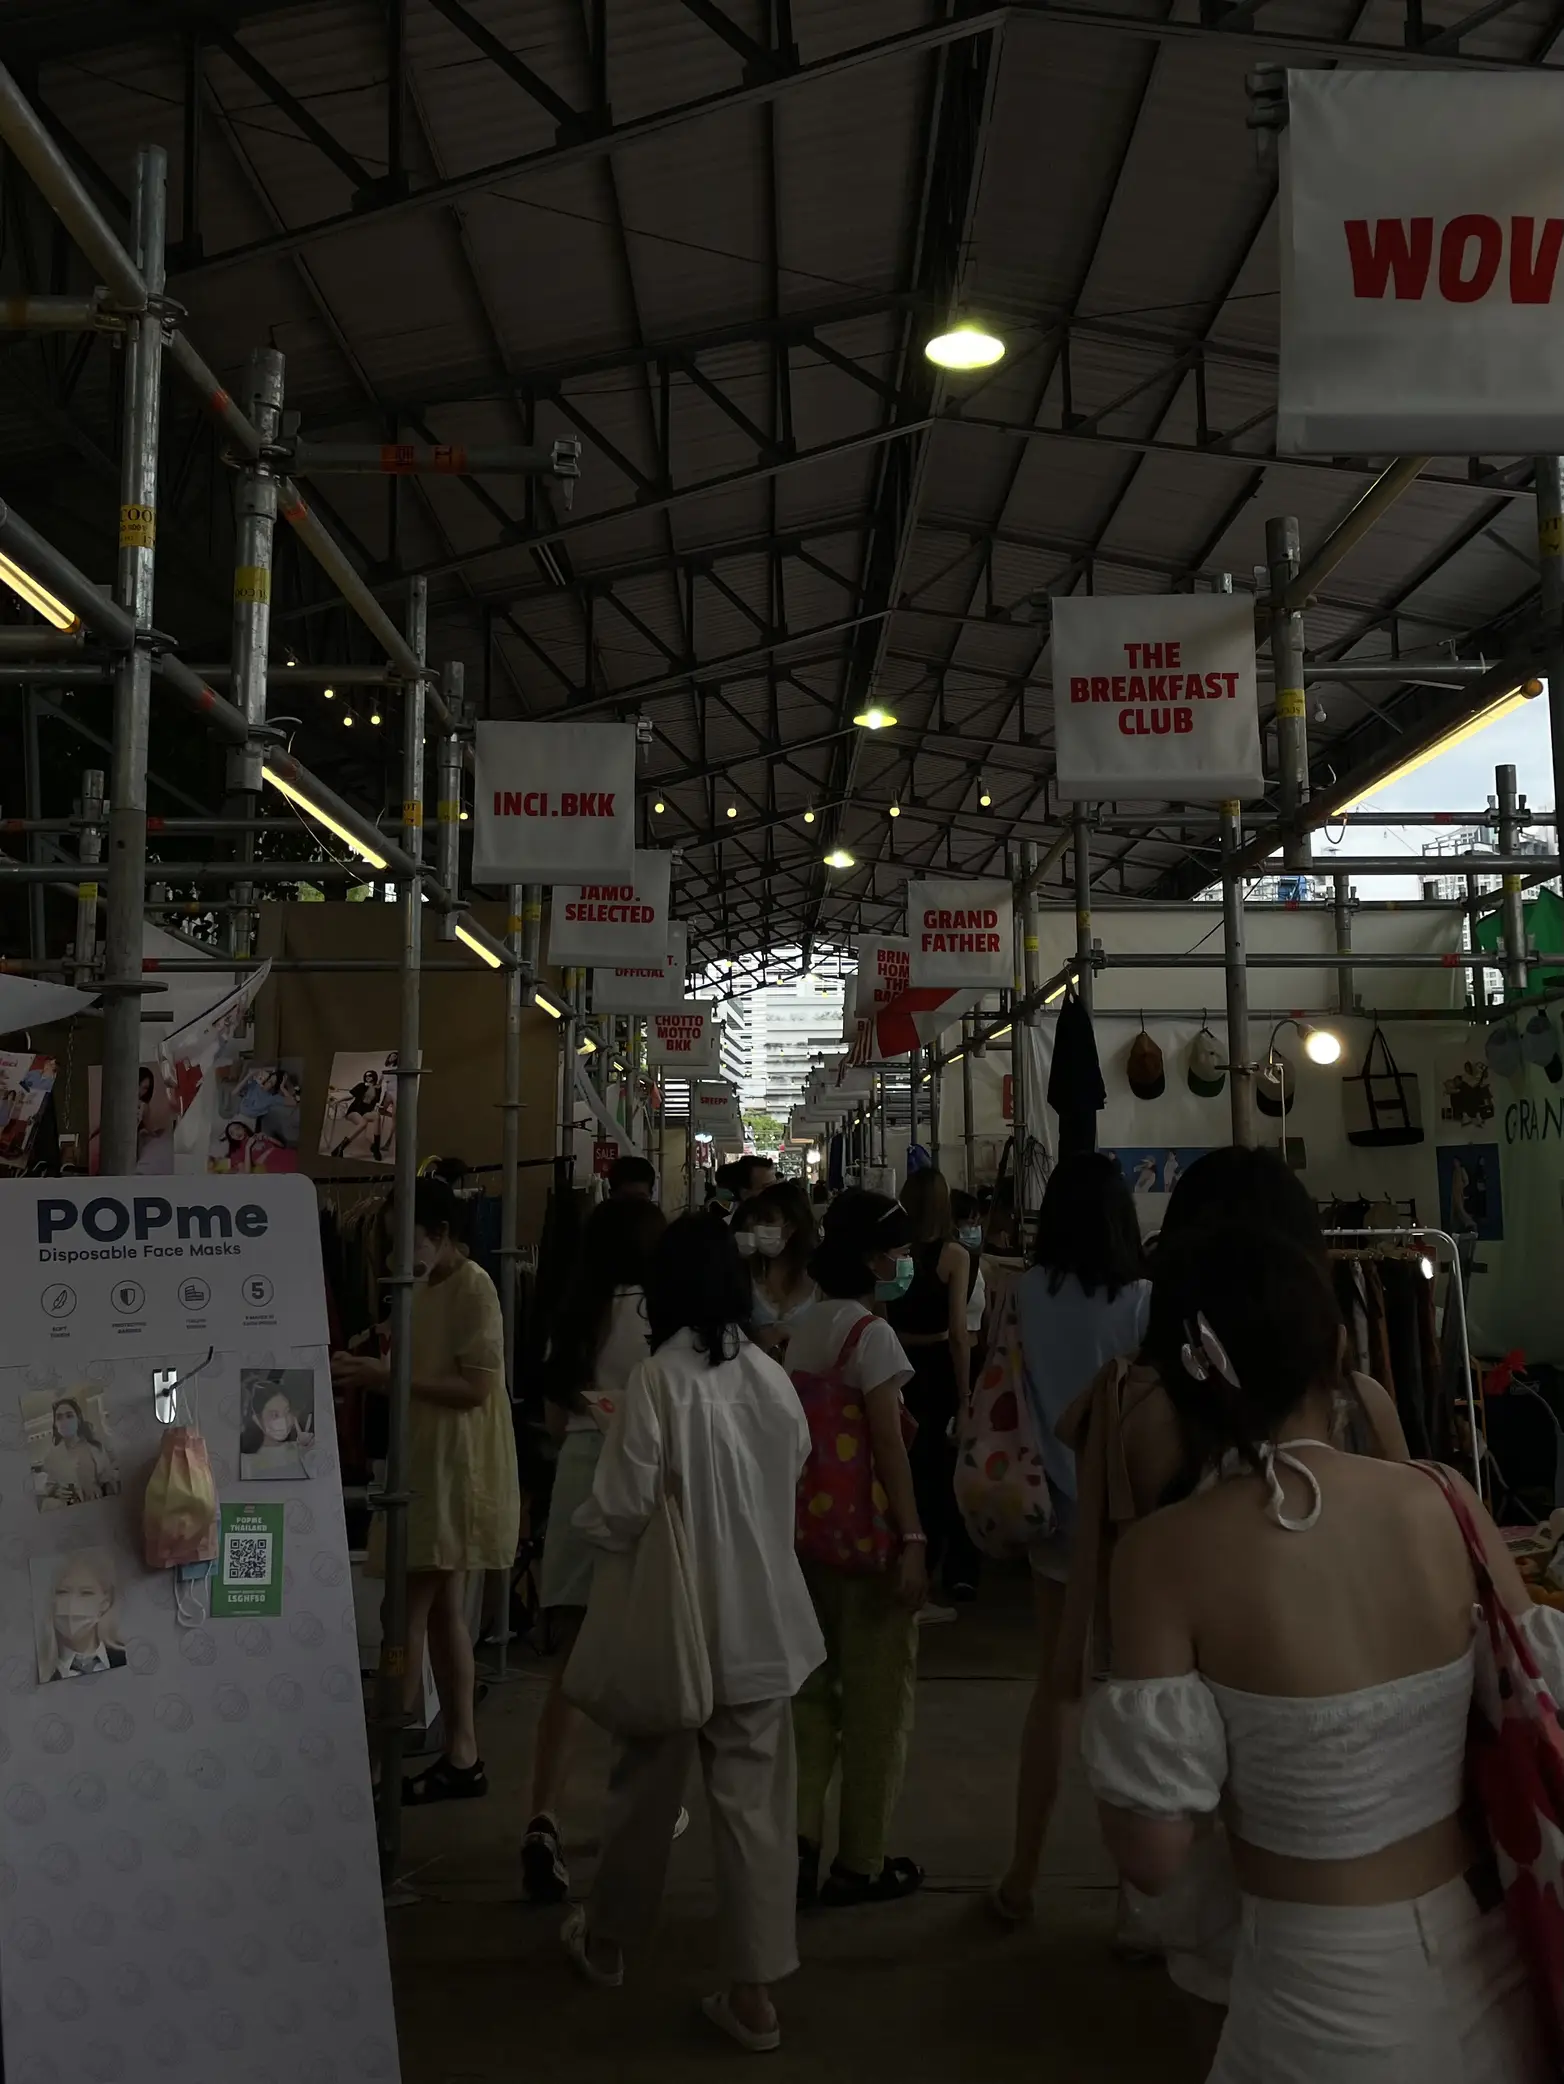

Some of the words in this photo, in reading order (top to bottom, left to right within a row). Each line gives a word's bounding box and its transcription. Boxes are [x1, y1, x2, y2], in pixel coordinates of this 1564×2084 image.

[1124, 642, 1181, 669] THE
[1070, 672, 1239, 702] BREAKFAST
[1118, 707, 1193, 735] CLUB
[494, 792, 616, 817] INCI.BKK
[565, 903, 655, 923] SELECTED
[923, 910, 998, 929] GRAND
[921, 933, 1001, 952] FATHER
[655, 1015, 704, 1026] CHOTTO
[657, 1027, 702, 1039] MOTTO
[666, 1039, 691, 1051] BKK
[596, 1147, 616, 1160] SALE
[37, 1197, 268, 1243] POPme
[39, 1246, 137, 1263] Disposable
[143, 1245, 184, 1258] Face
[189, 1242, 241, 1256] Masks
